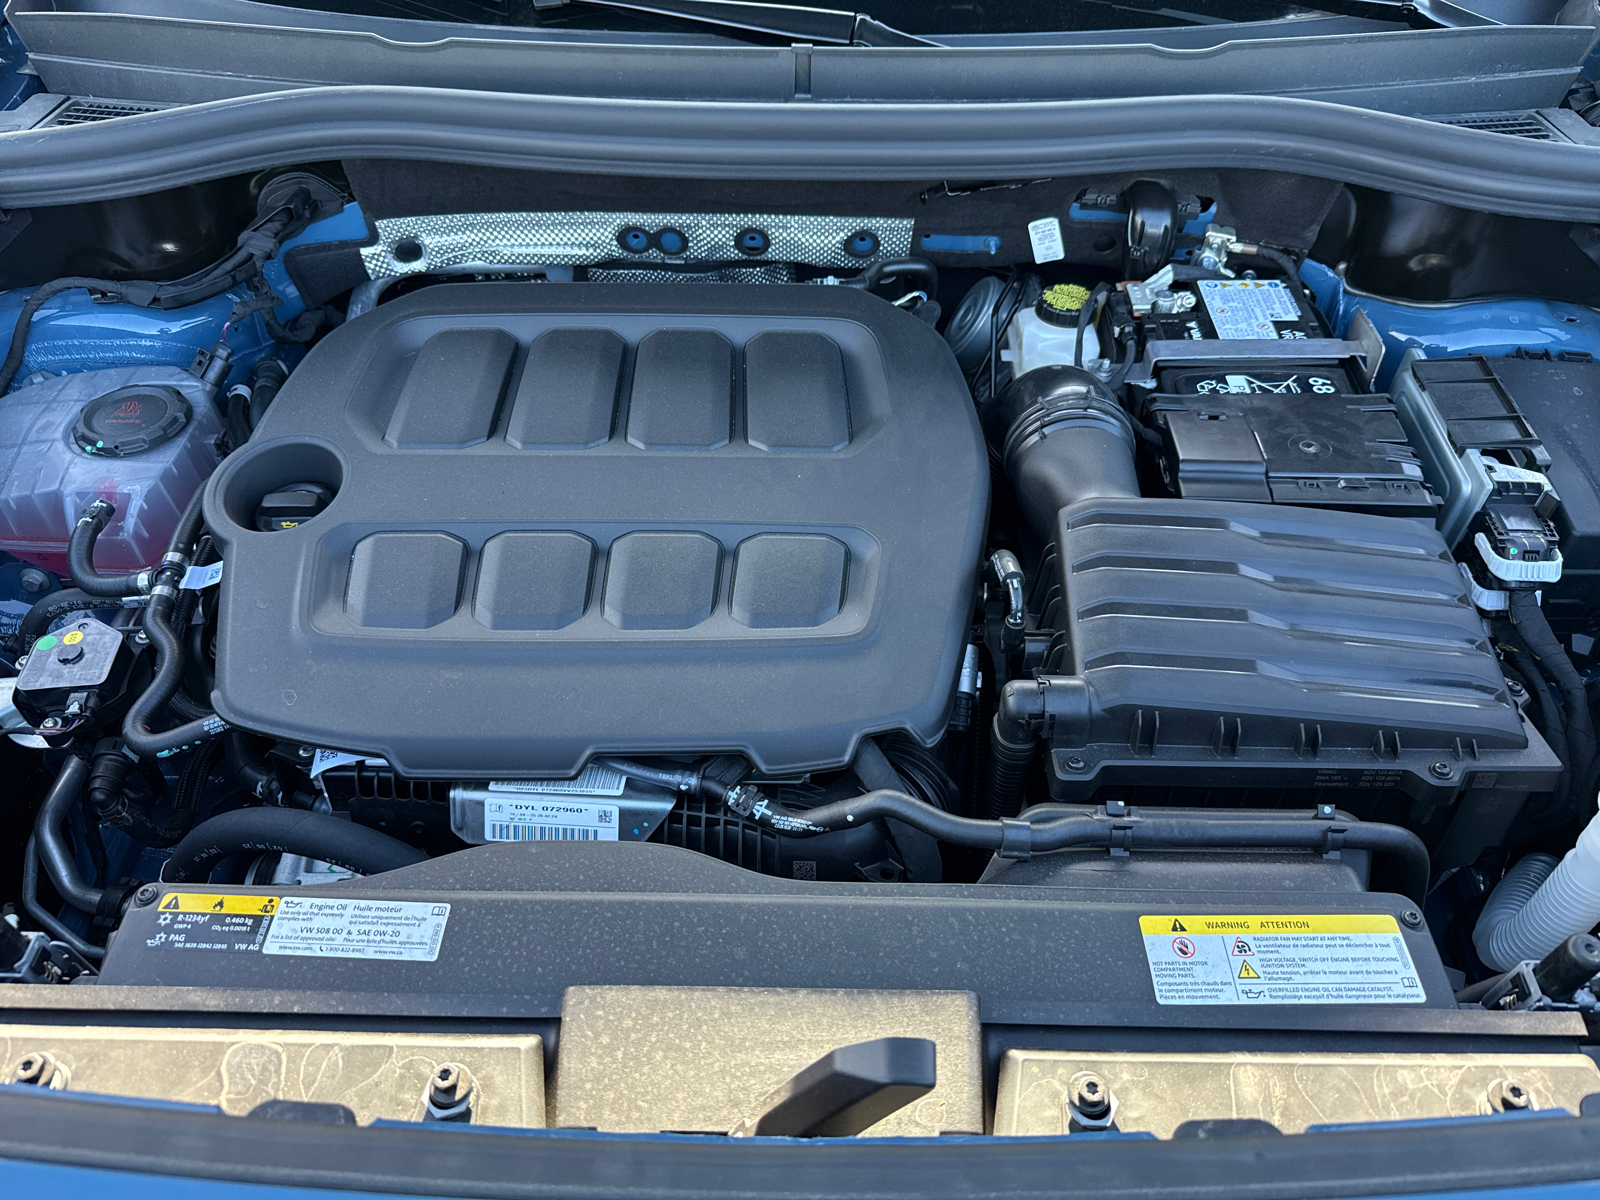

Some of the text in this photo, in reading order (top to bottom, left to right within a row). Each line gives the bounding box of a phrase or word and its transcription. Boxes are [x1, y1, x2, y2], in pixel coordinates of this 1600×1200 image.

[309, 903, 335, 911] Engine
[177, 914, 210, 924] R-1234yf
[245, 917, 253, 925] kg
[1205, 921, 1310, 929] WARNING ATTENTION
[373, 929, 400, 937] 0W-20
